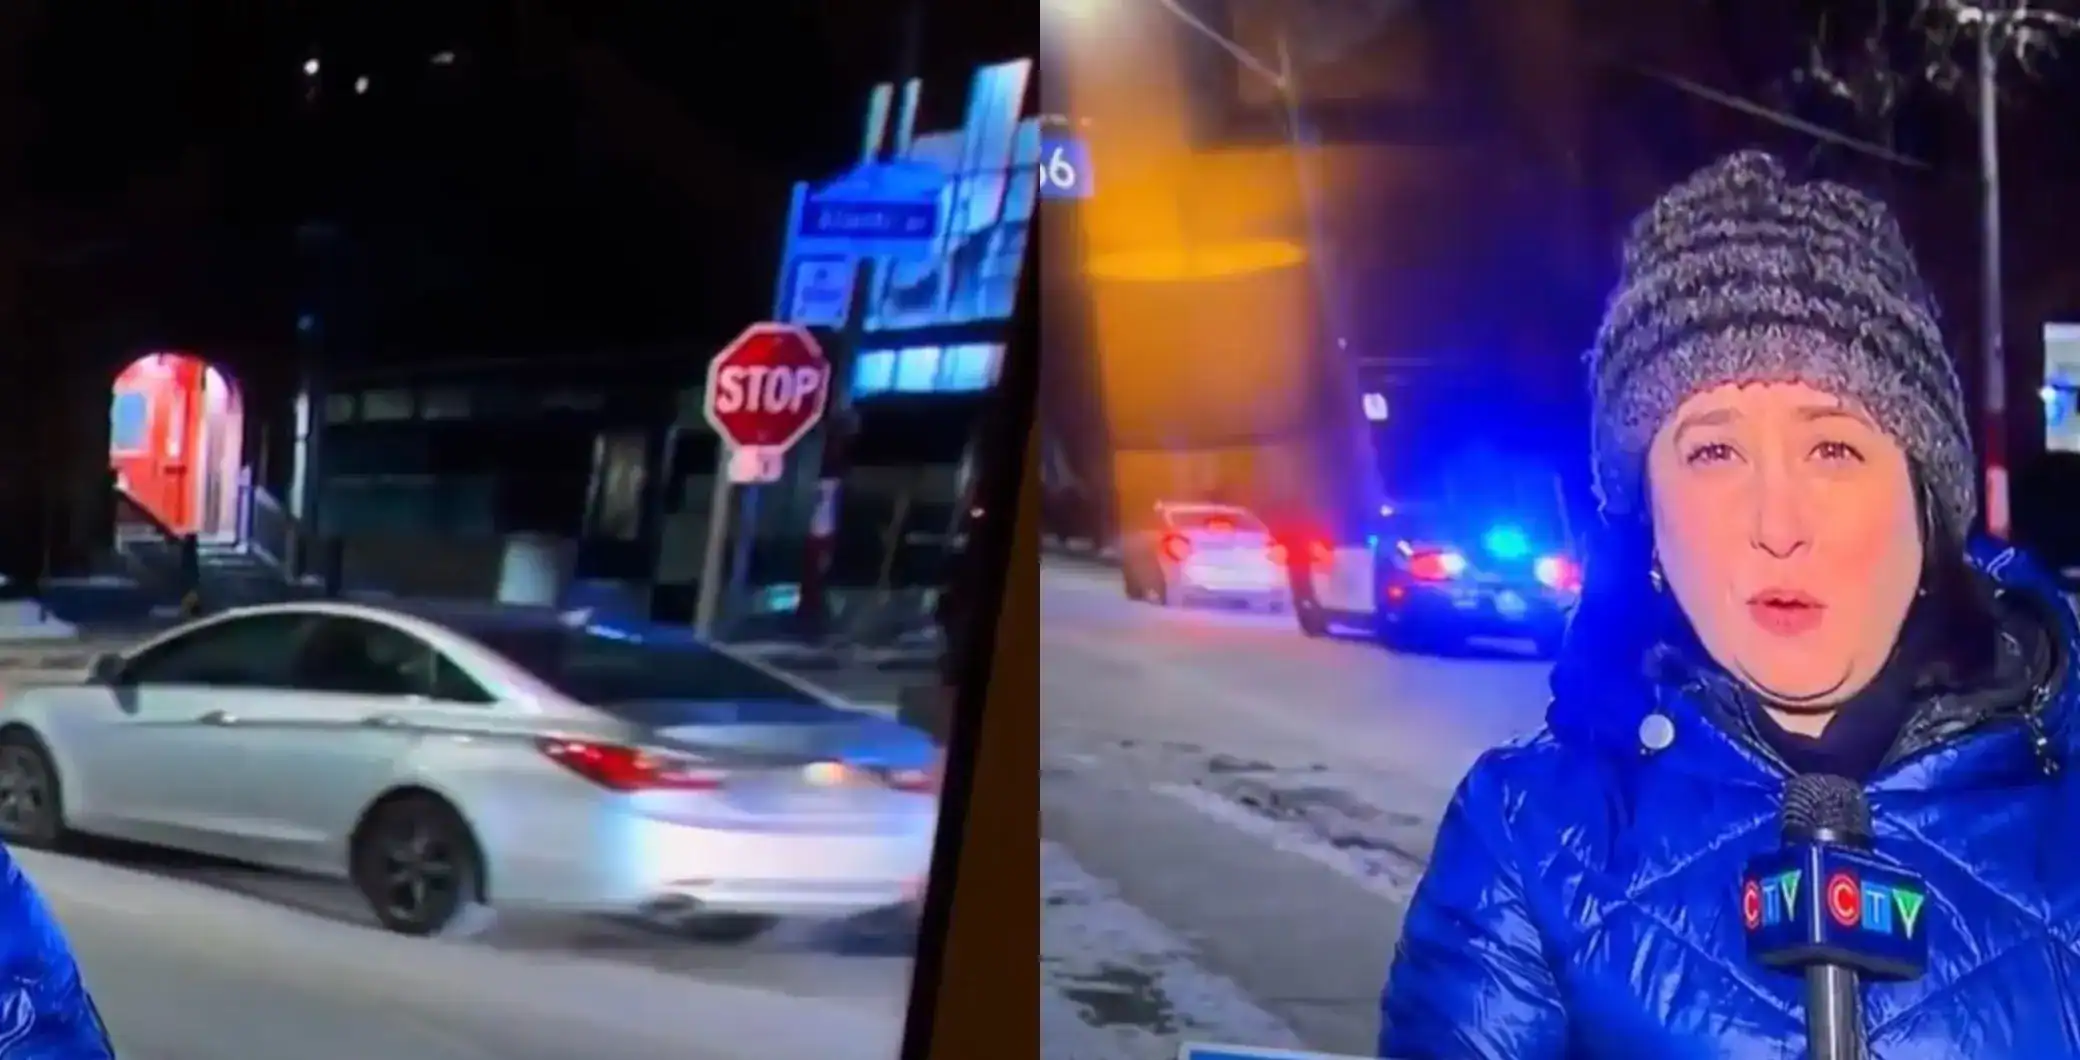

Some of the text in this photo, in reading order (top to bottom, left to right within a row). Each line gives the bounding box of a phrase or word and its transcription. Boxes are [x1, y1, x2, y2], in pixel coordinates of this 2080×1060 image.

[716, 365, 820, 414] STOP
[1743, 868, 1802, 929] CTV
[1828, 874, 1925, 940] CTV
